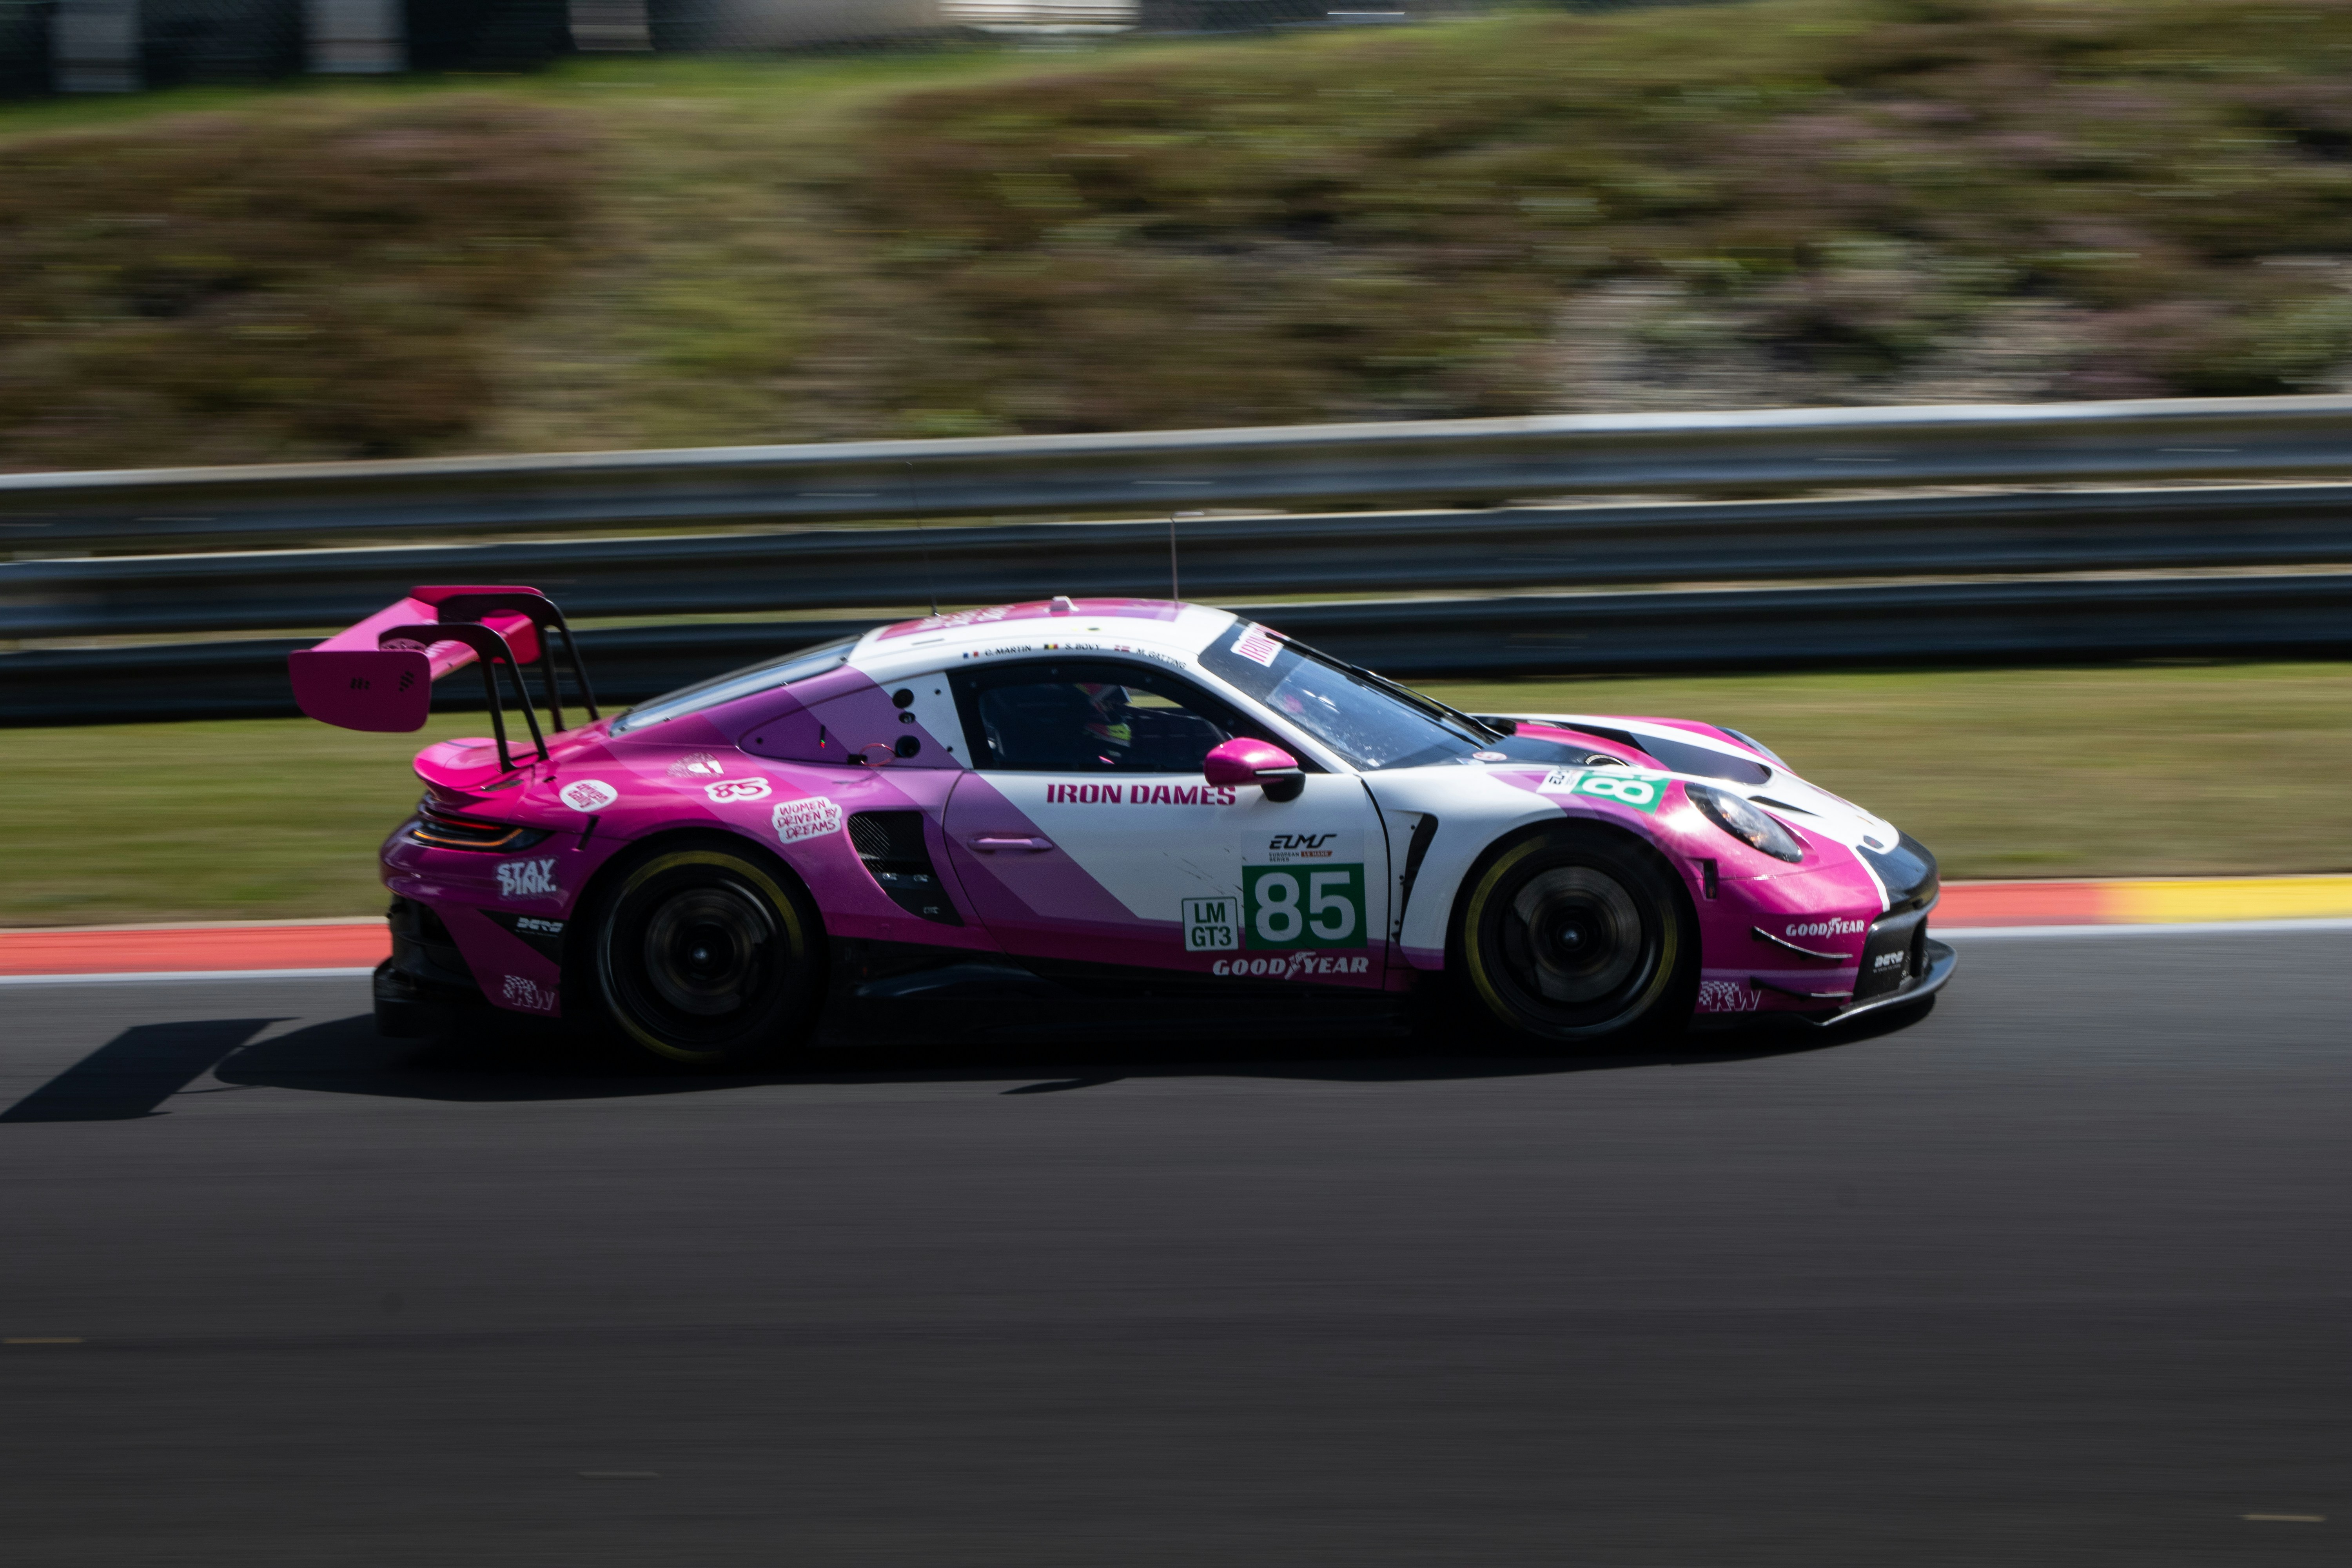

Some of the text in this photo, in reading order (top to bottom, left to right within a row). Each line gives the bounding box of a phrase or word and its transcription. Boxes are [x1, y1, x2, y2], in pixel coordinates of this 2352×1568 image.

[995, 644, 1032, 655] MARTIN
[713, 780, 763, 798] 85
[1047, 784, 1236, 805] IRON DAMES
[1582, 771, 1664, 804] 8
[777, 807, 837, 828] DRIVEN BY
[779, 800, 826, 815] WOMEN
[786, 818, 836, 839] DREAMS
[496, 858, 555, 882] STAY
[1194, 902, 1226, 923] LM
[1255, 871, 1356, 942] 85
[1191, 926, 1232, 947] GT3
[1786, 917, 1864, 939] GOODYEAR
[1212, 952, 1369, 980] GOODYEAR
